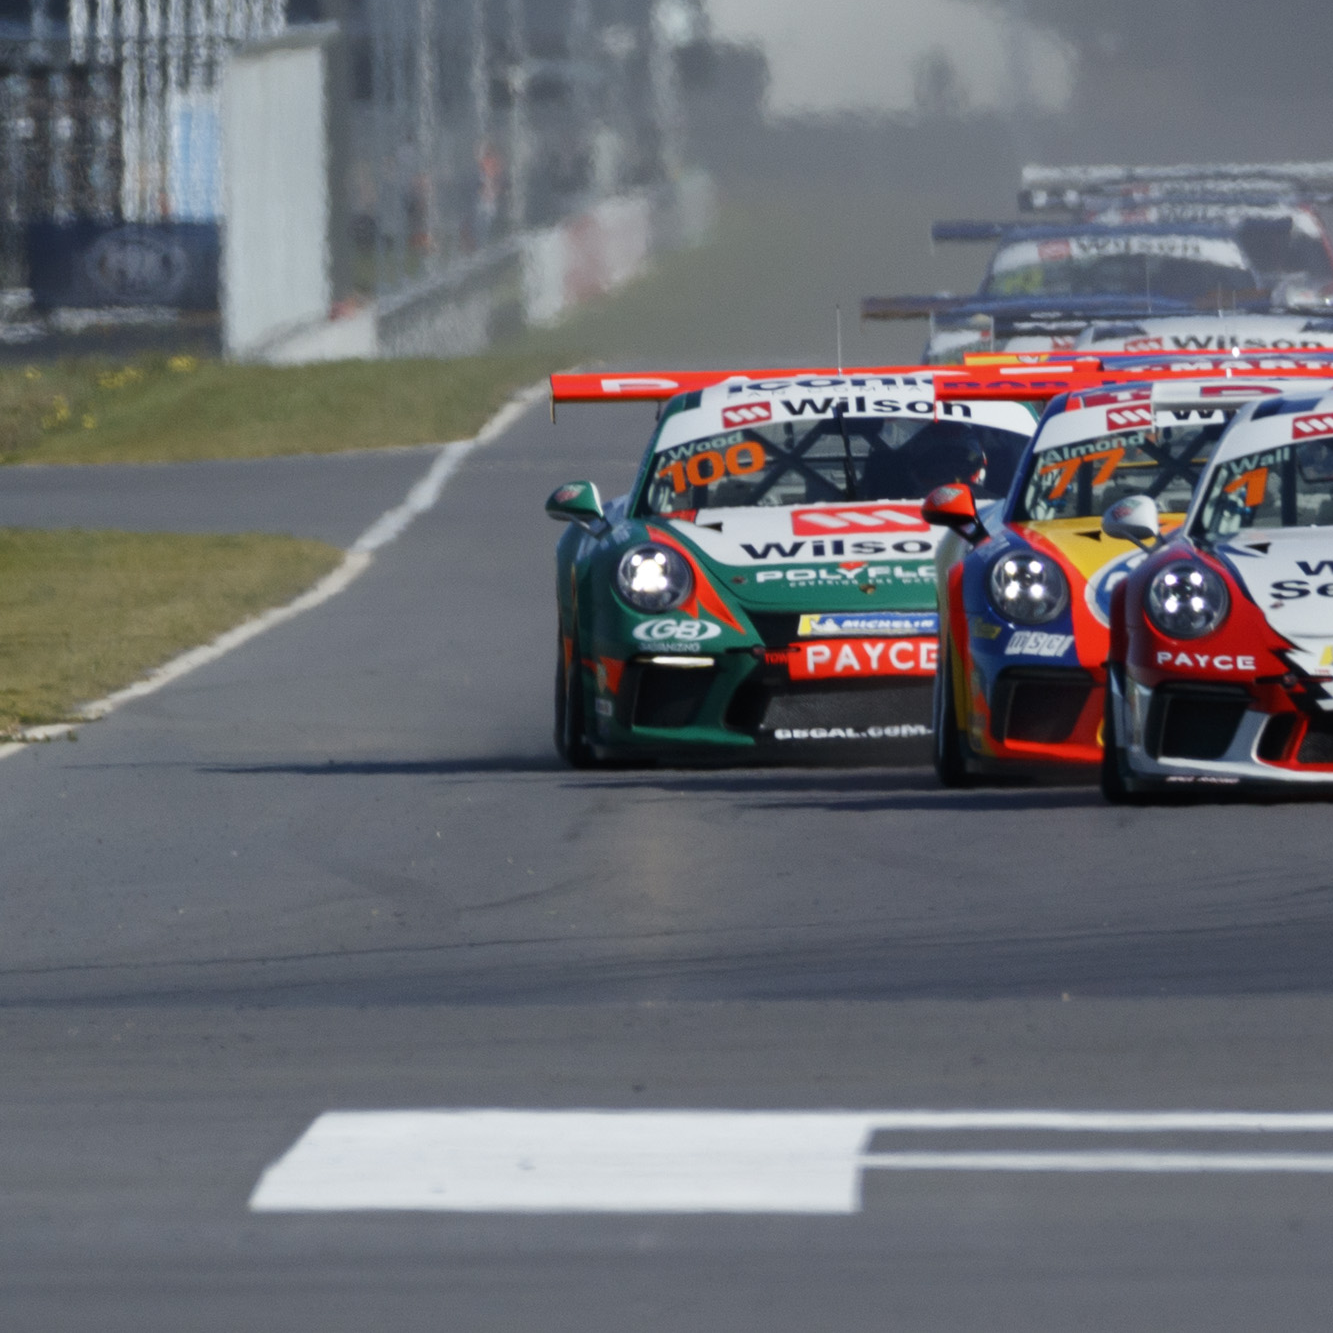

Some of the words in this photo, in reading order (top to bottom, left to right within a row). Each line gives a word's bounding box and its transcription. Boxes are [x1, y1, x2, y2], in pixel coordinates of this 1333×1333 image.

[1170, 335, 1324, 350] Wilson
[781, 396, 971, 418] Wilson
[669, 432, 744, 462] Wood
[1045, 431, 1145, 464] Almond
[1231, 447, 1290, 474] Wall
[659, 441, 766, 494] 100
[1040, 448, 1125, 500] 77
[1225, 467, 1268, 507] 1
[740, 540, 933, 560] Wilso
[841, 618, 935, 629] MICHELIN
[807, 642, 938, 673] PAYCE
[1156, 651, 1256, 671] PAYCE
